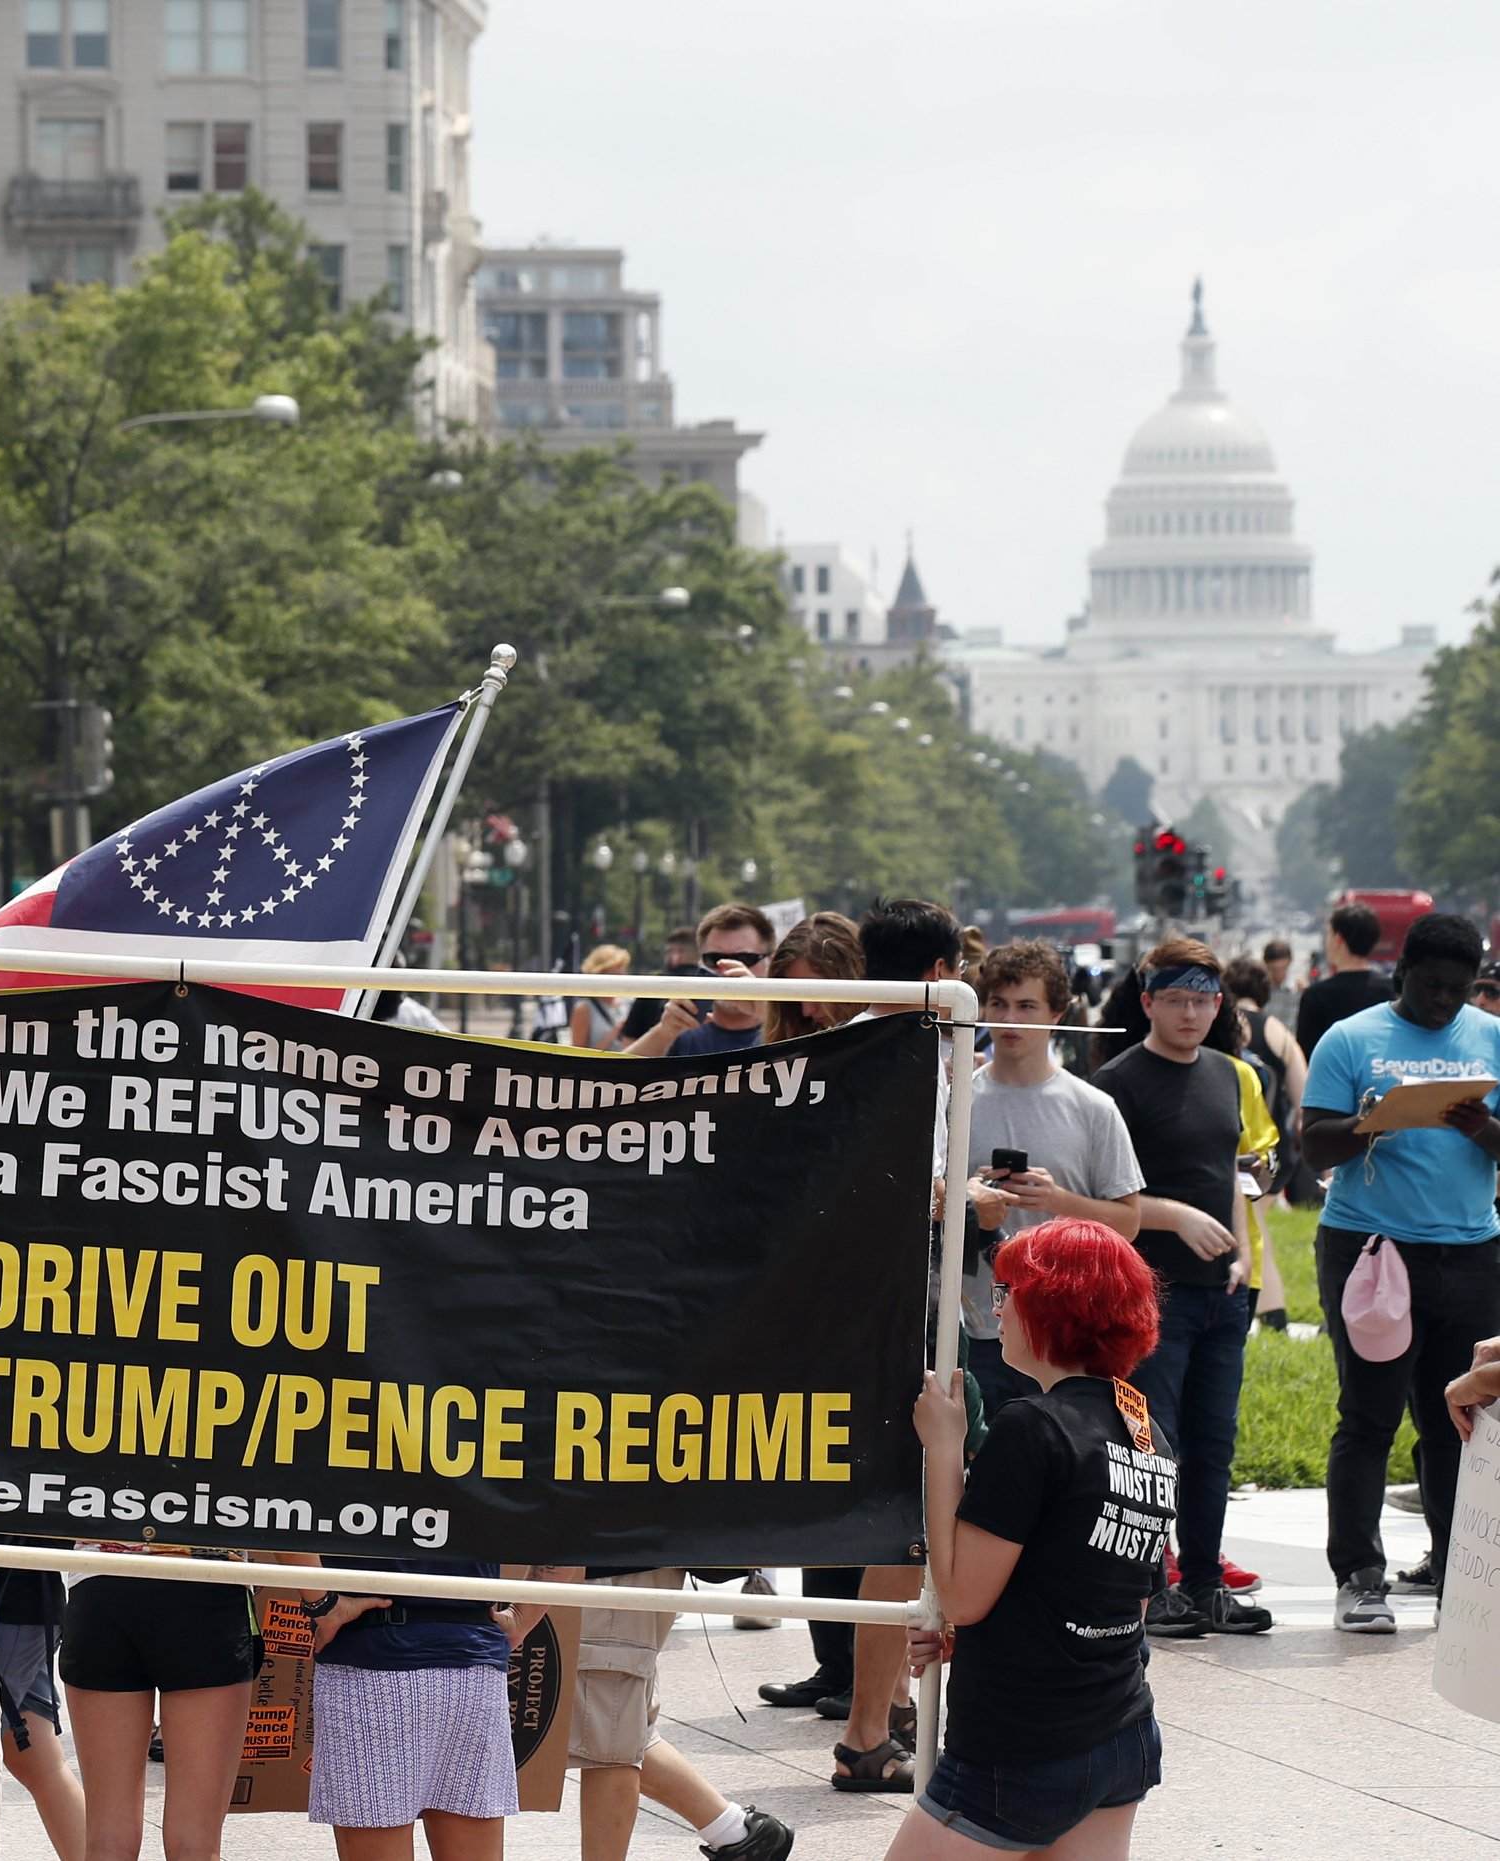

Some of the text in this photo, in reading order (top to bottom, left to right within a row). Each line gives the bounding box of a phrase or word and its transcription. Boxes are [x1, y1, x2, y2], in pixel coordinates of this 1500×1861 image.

[73, 1006, 179, 1062] the
[203, 1023, 380, 1089] name
[403, 1063, 471, 1102] of
[494, 1057, 826, 1110] humanity,
[108, 1075, 362, 1148] REFUSE
[384, 1105, 451, 1155] to
[473, 1110, 716, 1175] Accept
[41, 1142, 288, 1211] Fascist
[308, 1161, 589, 1230] America
[230, 1254, 380, 1353] OUT
[1115, 1379, 1145, 1409] Trump/
[1118, 1396, 1145, 1422] Pence
[554, 1392, 851, 1482] REGIME
[1106, 1441, 1131, 1467] THIS
[1108, 1460, 1177, 1510] MUST EN
[1102, 1501, 1119, 1520] THE
[1122, 1507, 1163, 1533] TRUMP/PENCE
[1088, 1516, 1152, 1562] MUST
[269, 1601, 307, 1618] Trum
[269, 1615, 311, 1630] Pence
[263, 1629, 313, 1644] MUST GO!
[257, 1674, 276, 1706] bette
[294, 1686, 304, 1697] of
[524, 1646, 547, 1730] PROJECT
[246, 1722, 288, 1733] Pence
[248, 1708, 294, 1721] rump/
[273, 1735, 291, 1744] GO!
